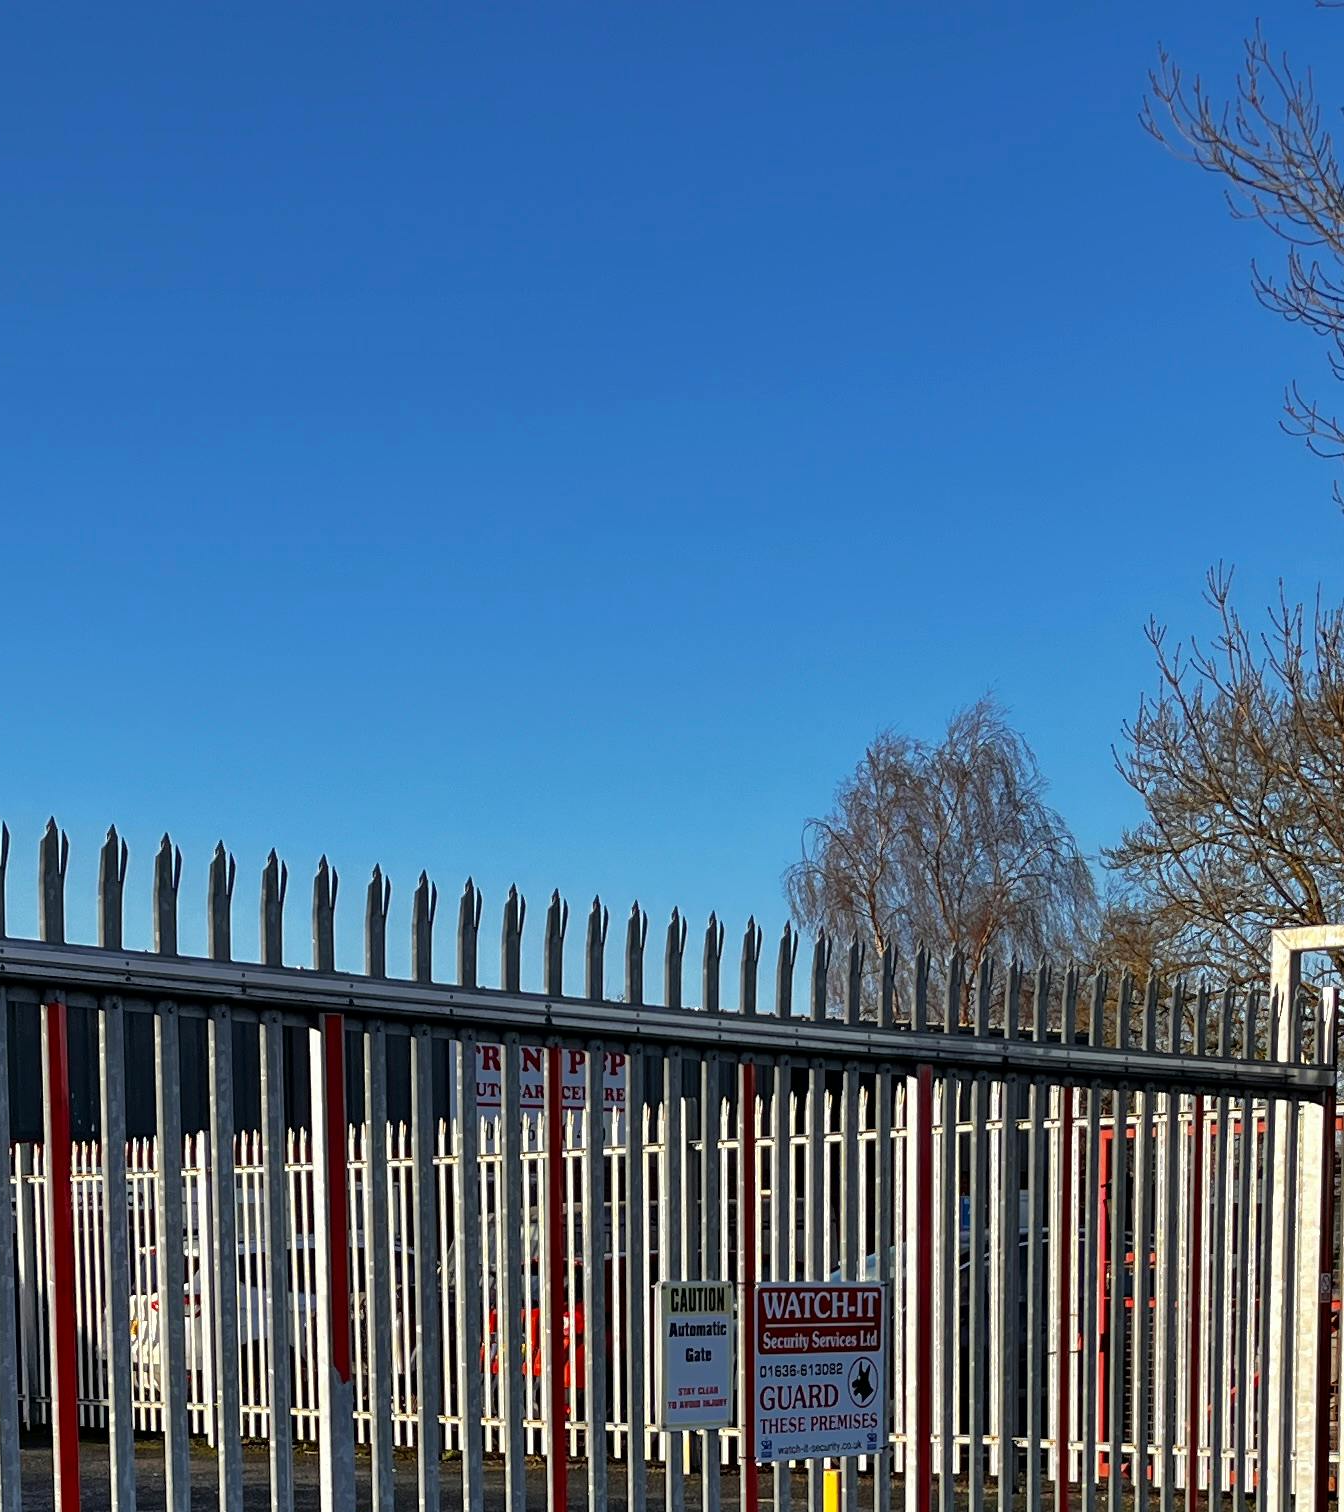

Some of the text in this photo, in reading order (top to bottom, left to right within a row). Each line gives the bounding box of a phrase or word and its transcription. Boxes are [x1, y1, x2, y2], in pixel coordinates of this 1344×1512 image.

[561, 1085, 626, 1102] CERE
[670, 1287, 725, 1312] CAUTION
[762, 1291, 879, 1320] WATCH-IT
[668, 1321, 727, 1338] Automatic
[762, 1330, 878, 1352] Security Services Ltd
[685, 1346, 712, 1363] Gate
[759, 1384, 840, 1412] GUARD
[759, 1412, 878, 1435] THESE PREMISES
